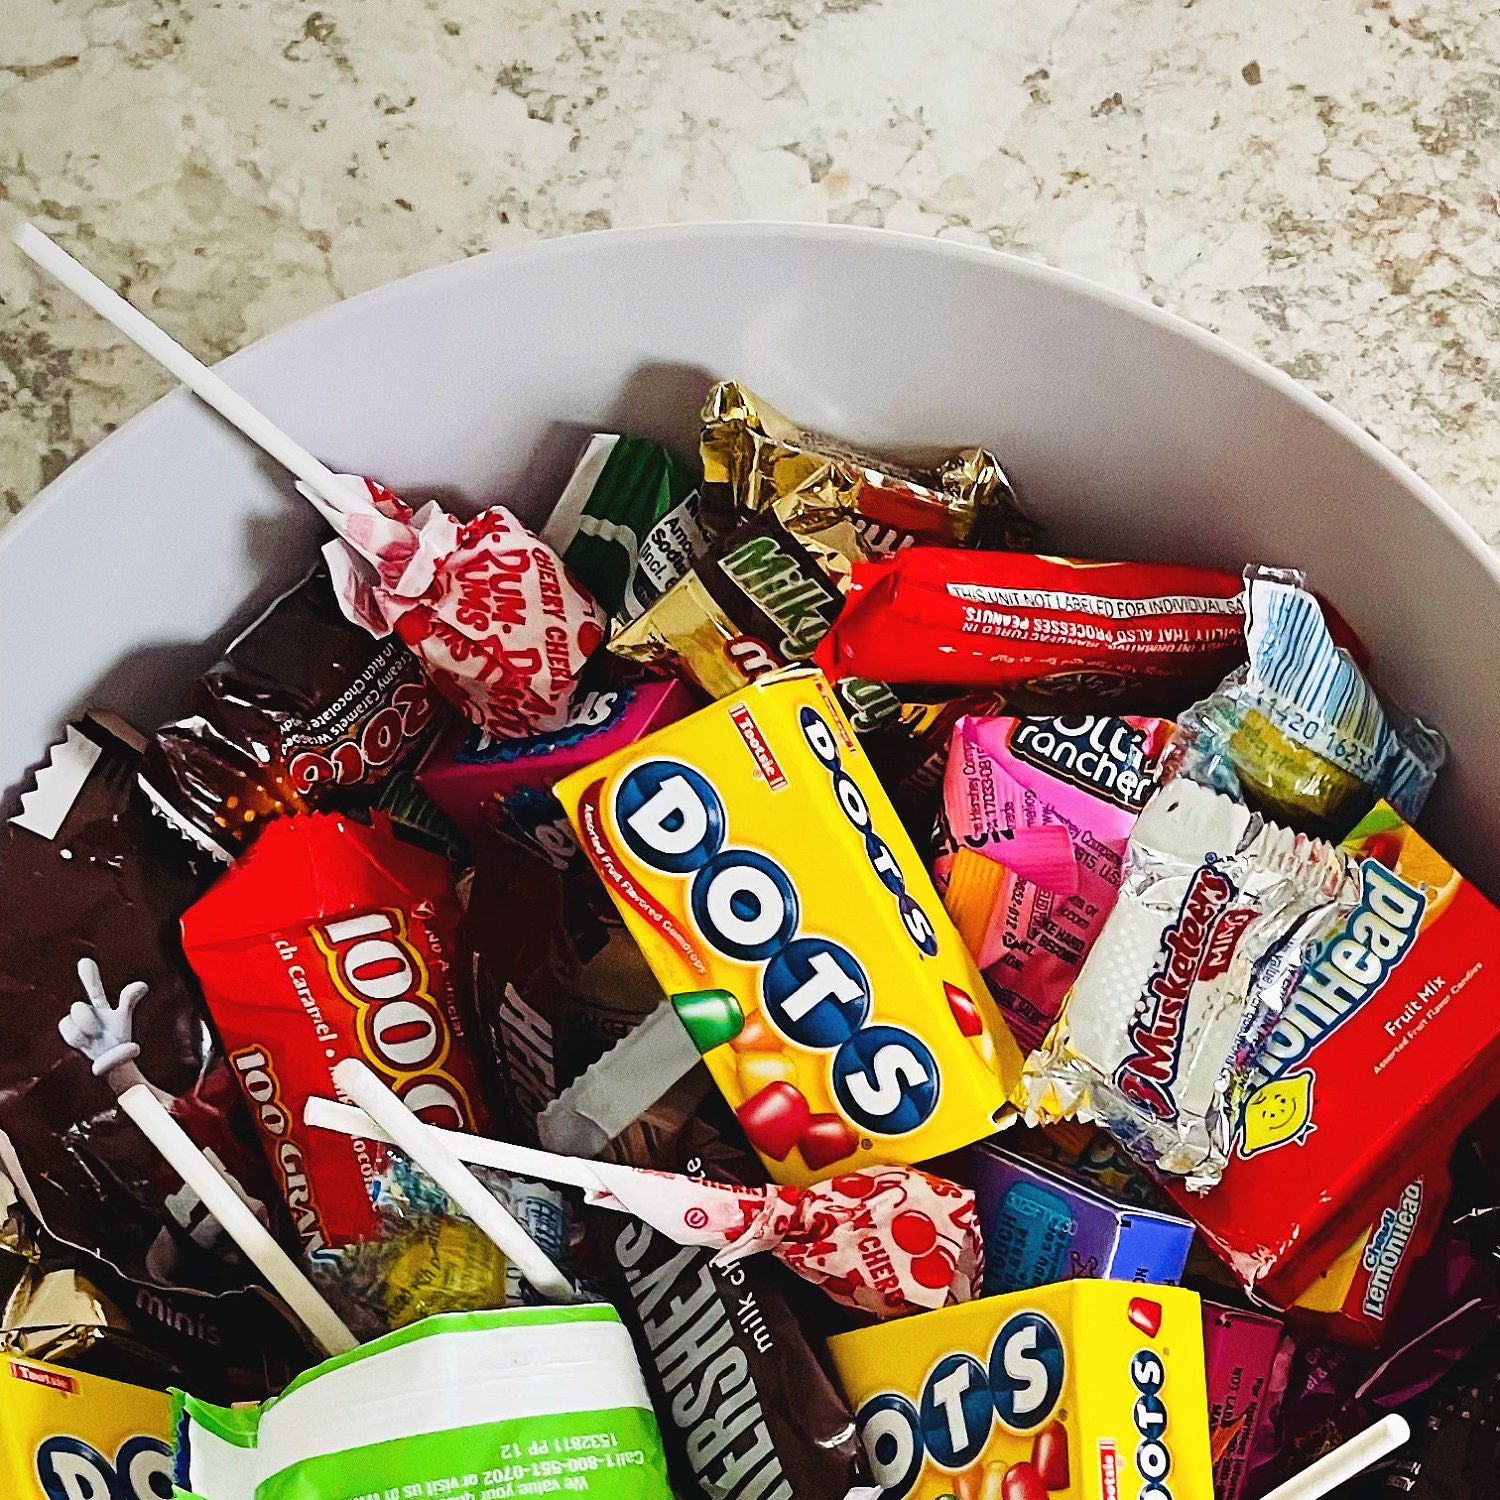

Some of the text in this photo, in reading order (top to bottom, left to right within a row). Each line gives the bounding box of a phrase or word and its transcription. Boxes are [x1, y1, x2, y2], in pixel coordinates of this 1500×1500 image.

[531, 547, 576, 692] CHERRY CHER
[718, 536, 834, 661] Milky
[953, 586, 987, 605] THIS
[988, 590, 1020, 608] UNIT
[1023, 593, 1055, 611] NOT
[1117, 600, 1146, 617] FOR
[1148, 598, 1225, 615] INDIVIDUAL
[1034, 619, 1115, 644] PROCESSES
[1116, 629, 1152, 643] ALSO
[1157, 628, 1194, 643] THAT
[309, 678, 366, 729] Chocolate
[739, 716, 775, 778] Tootsie
[1016, 725, 1152, 802] rancher
[804, 718, 934, 945] DOTS
[628, 774, 929, 1117] DOTS
[1127, 866, 1232, 1082] Musketeers
[287, 964, 338, 1043] Caramel
[325, 912, 438, 1065] 100
[1384, 975, 1447, 1037] Fruit Mix
[235, 1051, 326, 1251] 100 GRAN
[1366, 1176, 1421, 1320] LemonHead
[135, 1287, 223, 1348] minis
[736, 1292, 774, 1354] milk
[861, 1325, 1049, 1490] OTS
[500, 1432, 618, 1460] 1532811 PP 12
[403, 1483, 423, 1496] us
[461, 1472, 479, 1487] or
[518, 1479, 562, 1497] value
[564, 1475, 589, 1491] We
